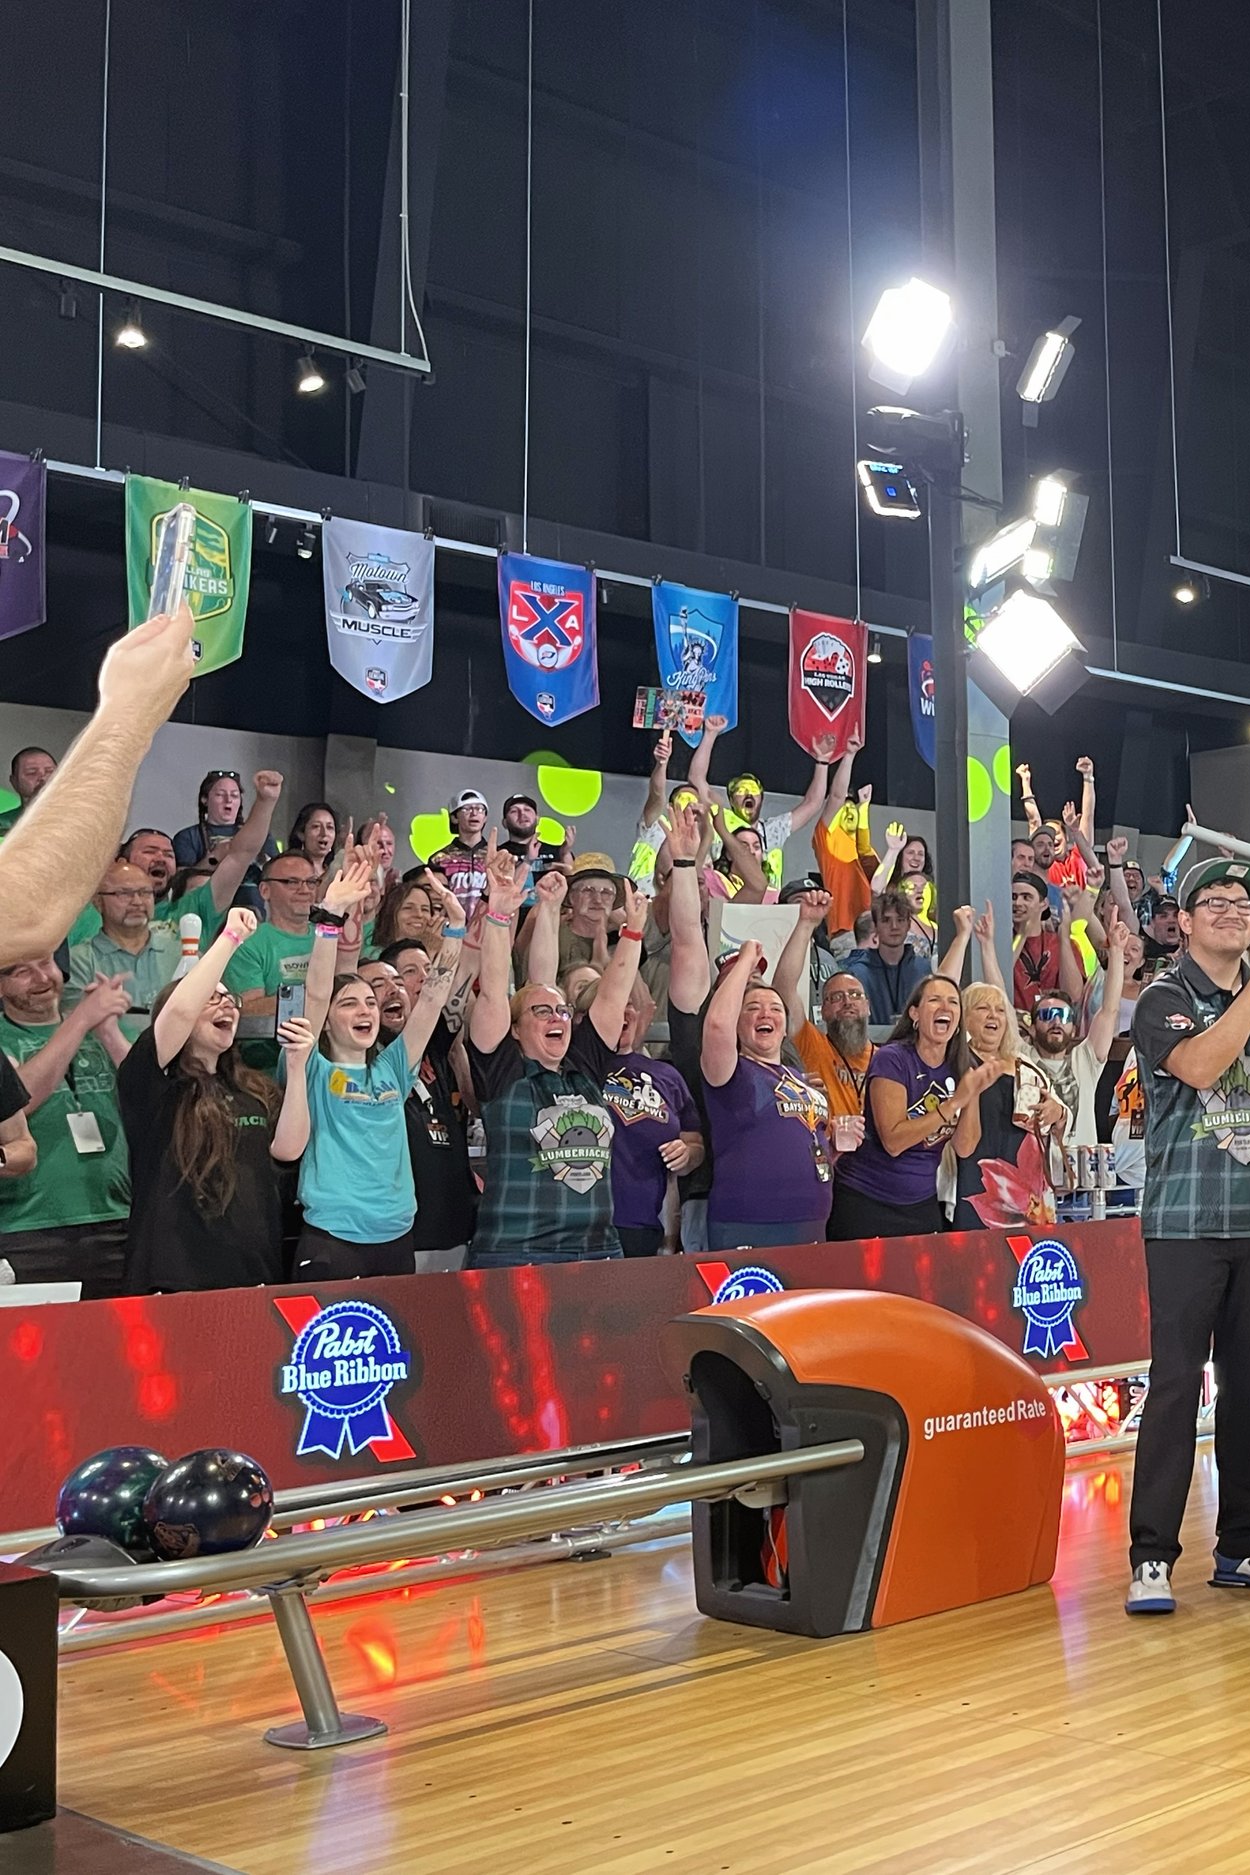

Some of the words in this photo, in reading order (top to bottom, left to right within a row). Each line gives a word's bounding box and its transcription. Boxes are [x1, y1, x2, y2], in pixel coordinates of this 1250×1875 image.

[184, 573, 229, 595] IKERS
[350, 562, 408, 584] Motown
[530, 580, 541, 593] LOS
[542, 582, 565, 597] ANGELES
[341, 618, 412, 639] MUSCLE
[513, 590, 580, 647] X
[804, 677, 824, 687] HIGH
[602, 1092, 636, 1110] AYSIDE
[429, 1129, 449, 1142] VIP
[540, 1147, 611, 1162] LUMBERJACKS
[1028, 1255, 1066, 1284] Pabst
[1012, 1285, 1041, 1308] Blue
[1040, 1281, 1083, 1304] Ribbon
[312, 1321, 379, 1360] Pabst
[281, 1363, 332, 1394] Blue
[333, 1356, 408, 1387] Ribbon
